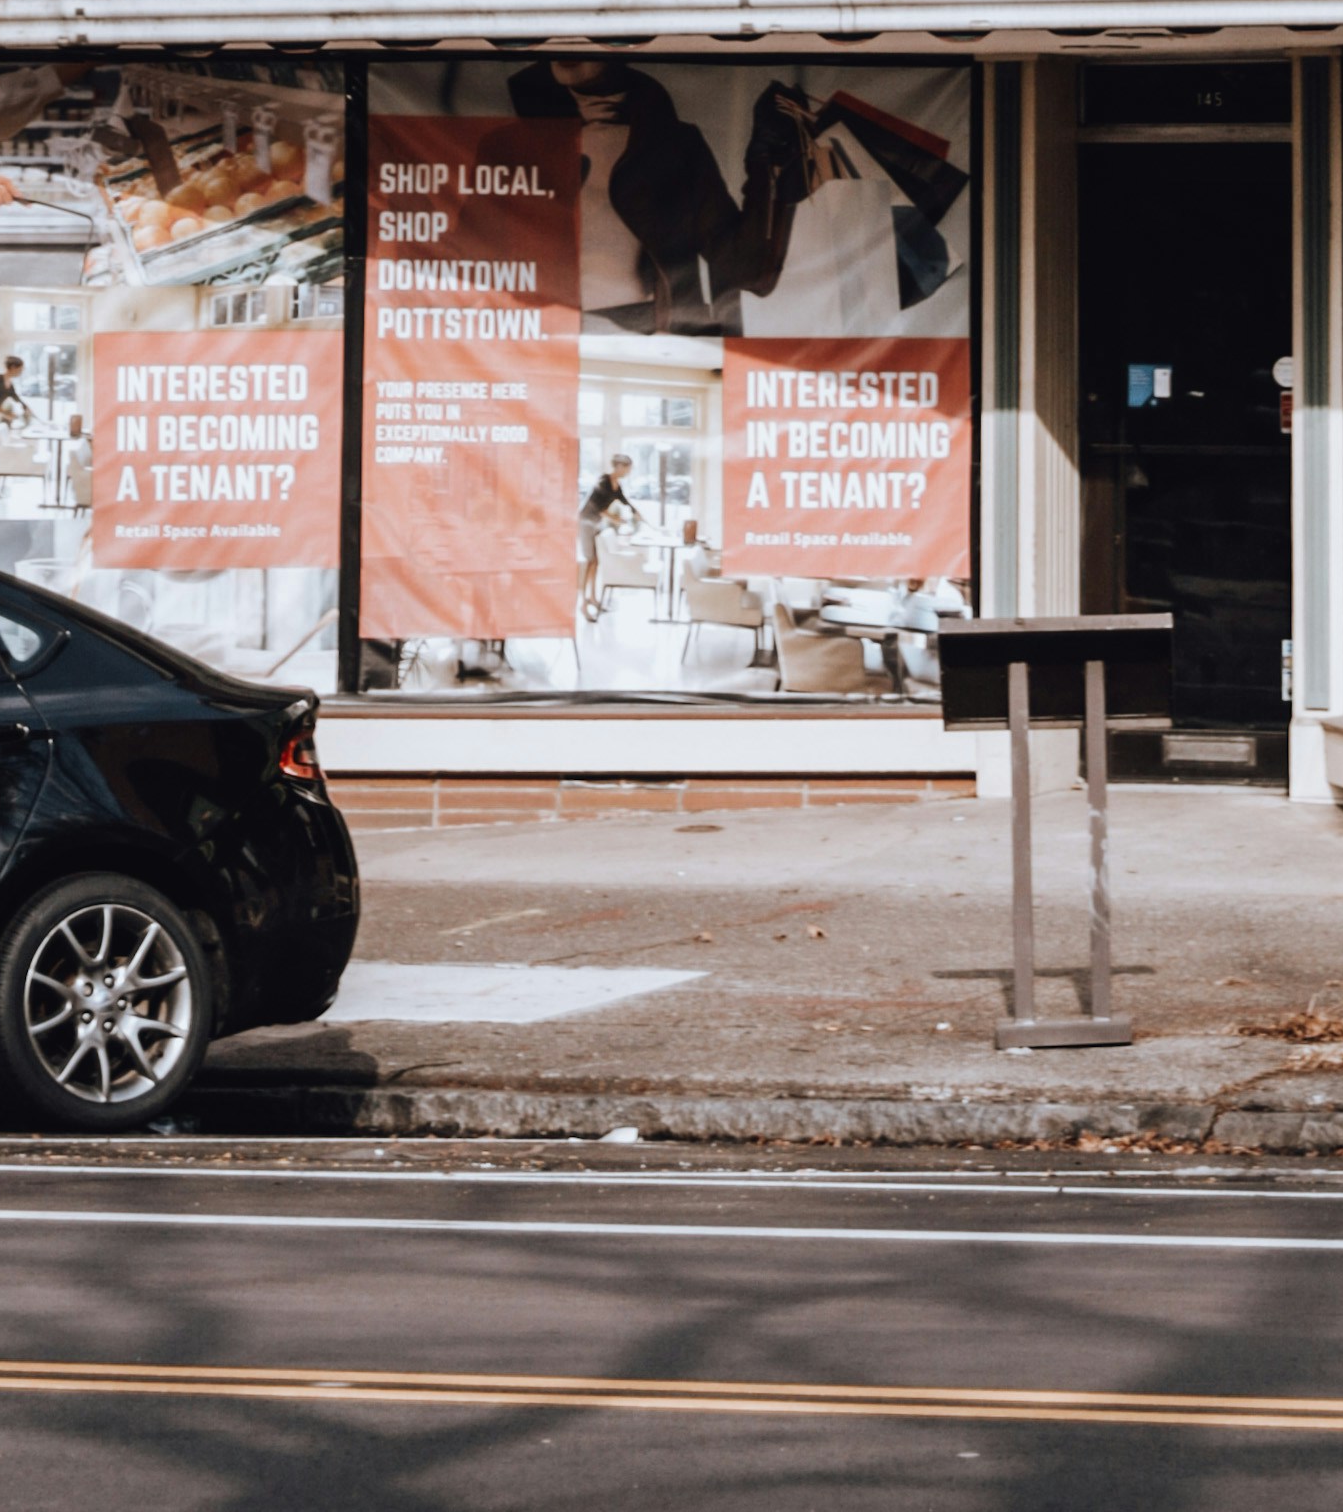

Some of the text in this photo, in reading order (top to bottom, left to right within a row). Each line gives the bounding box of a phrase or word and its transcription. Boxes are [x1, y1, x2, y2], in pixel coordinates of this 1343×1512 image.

[379, 163, 556, 200] SHOP LOCAL,
[378, 211, 449, 243] SHOP
[377, 258, 537, 293] DOWNTOWN
[377, 306, 550, 342] POTTSTOWN.
[116, 363, 310, 403] INTERESTED
[376, 380, 529, 400] YOUR PRESENCE HERE
[746, 370, 940, 409] INTERESTED
[375, 402, 412, 420] PUTS
[414, 403, 444, 421] YOU
[116, 413, 320, 453] IN BECOMING
[375, 424, 488, 443] EXCEPTIONALLY
[746, 420, 951, 459] IN BECOMING
[374, 445, 449, 464] COMPANY.
[115, 463, 297, 503] A TENANT?
[745, 470, 928, 510] A TENANT?
[114, 523, 282, 542] Retail Space Available
[744, 530, 914, 549] Retail Space Available
